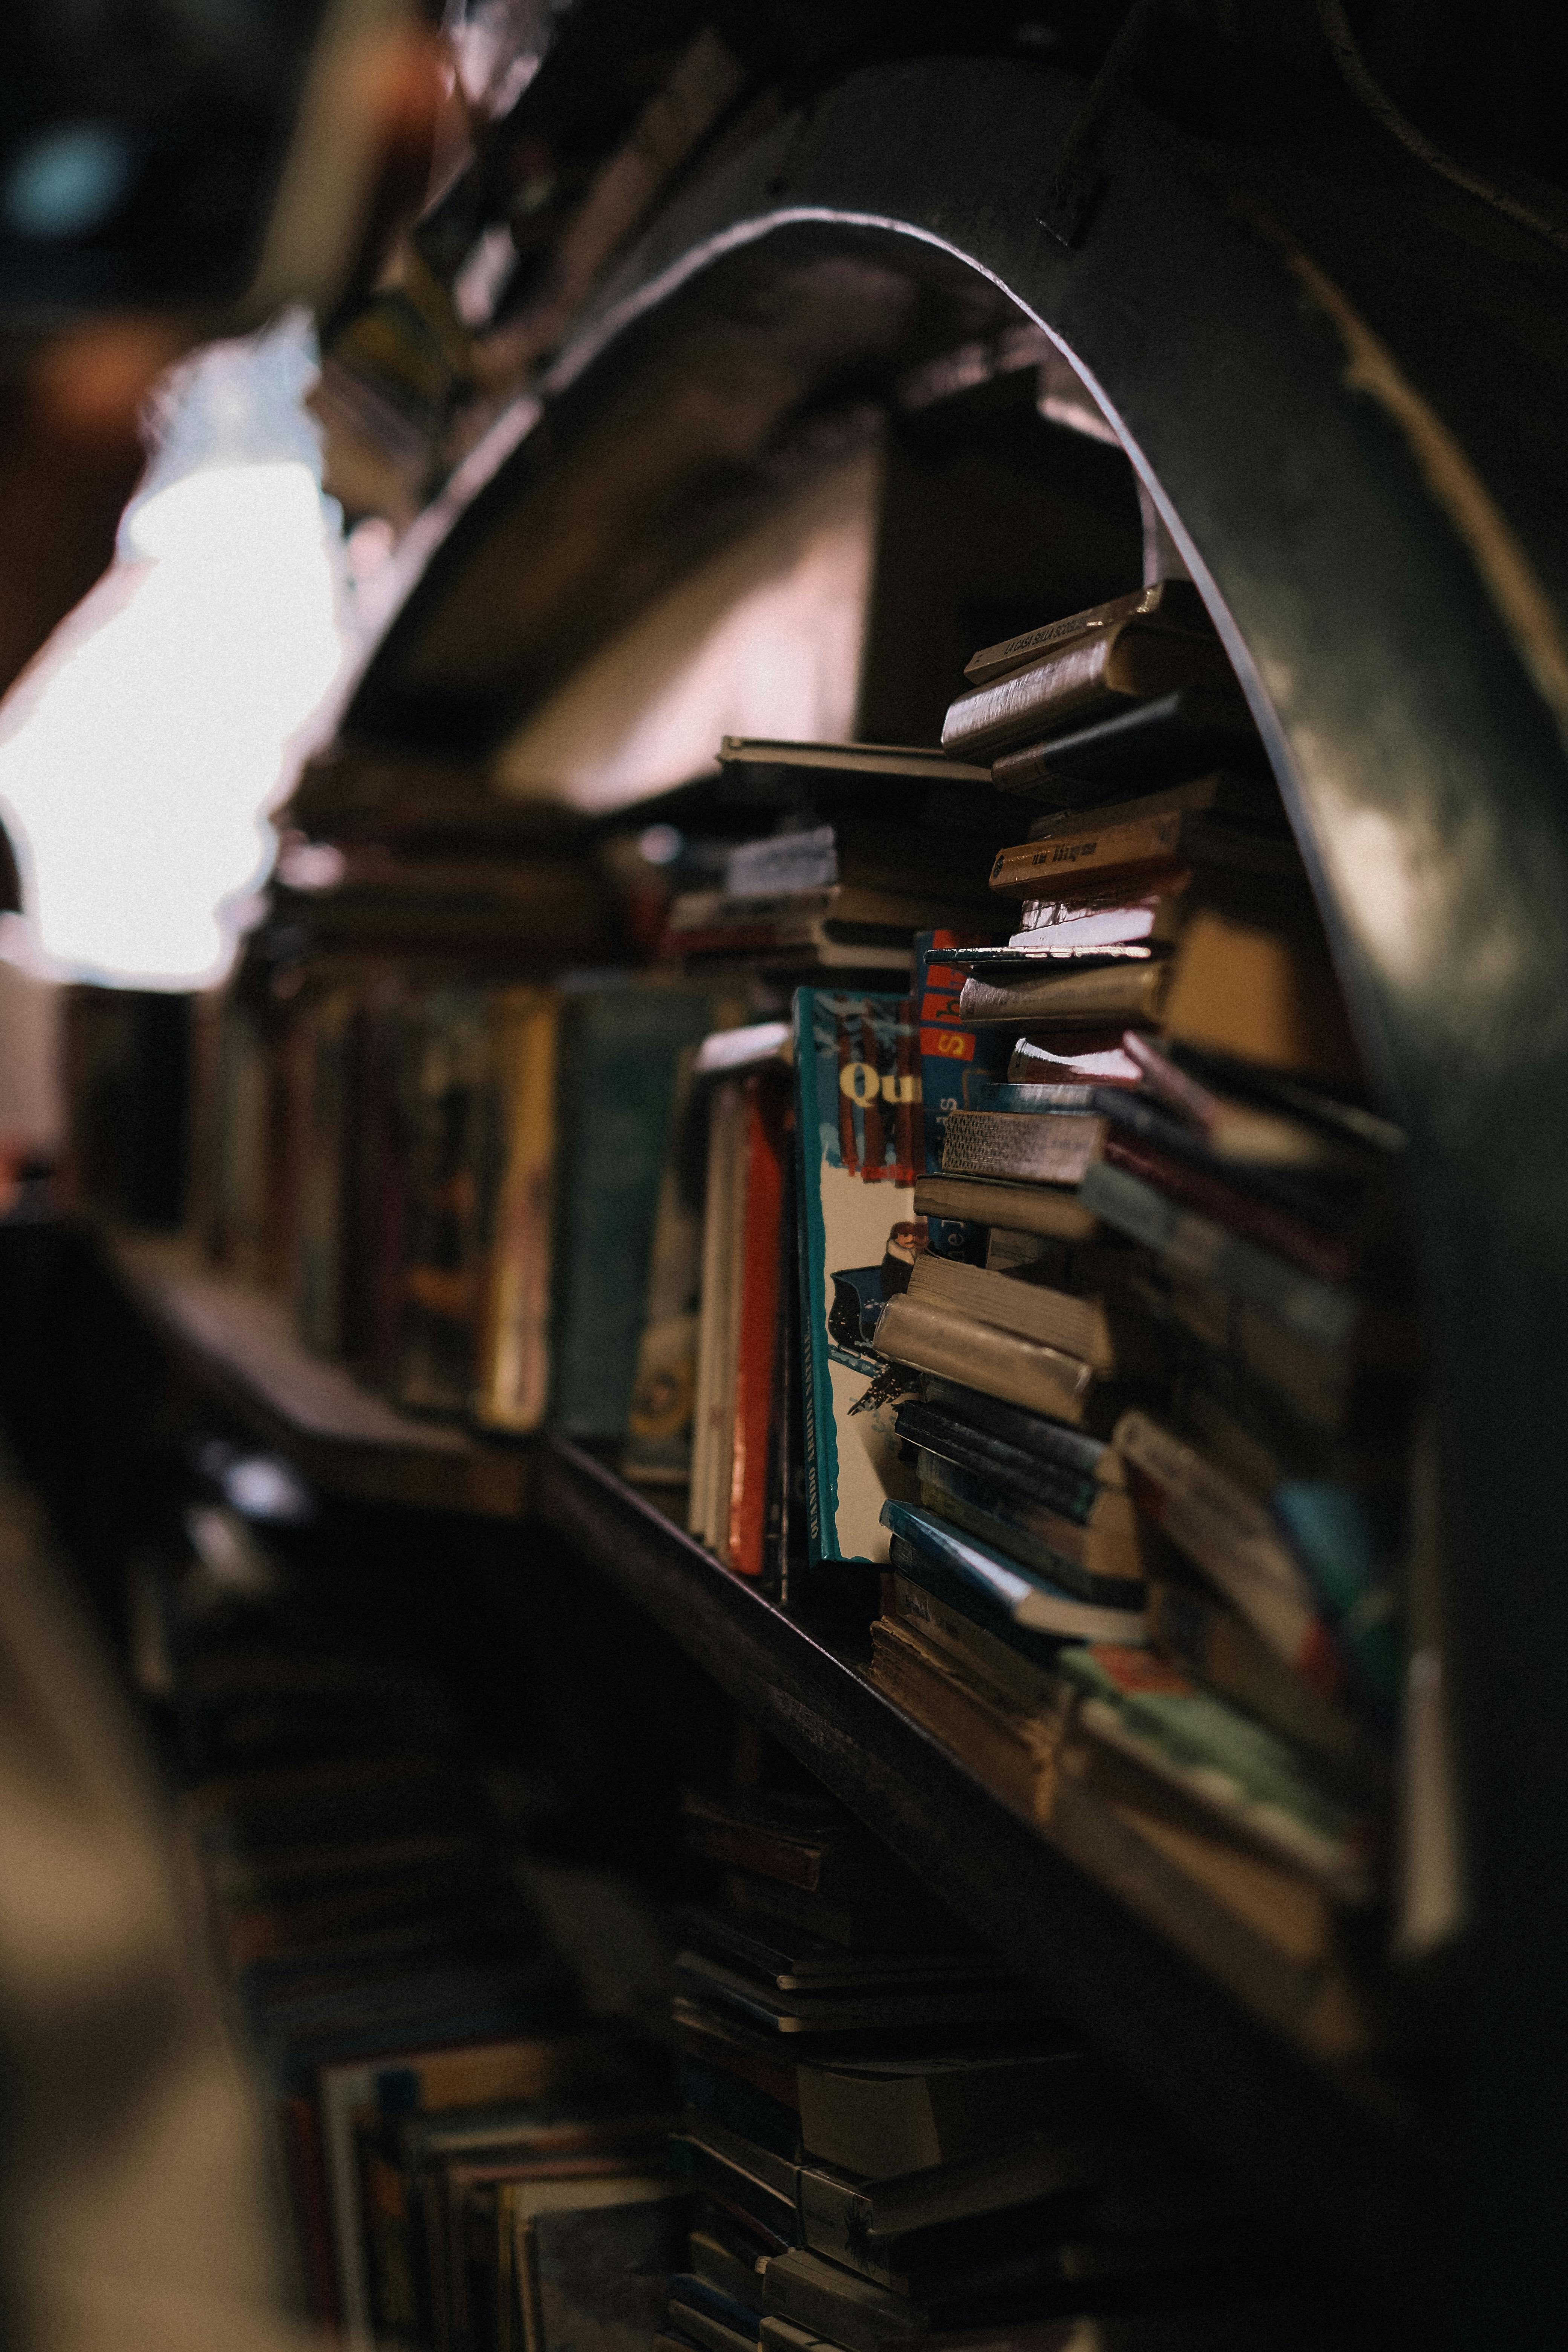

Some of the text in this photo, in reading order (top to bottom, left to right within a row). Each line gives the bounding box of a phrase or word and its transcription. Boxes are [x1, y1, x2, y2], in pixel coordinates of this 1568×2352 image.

[1004, 643, 1015, 655] LA
[1014, 635, 1034, 652] CASA
[1032, 628, 1054, 645] SULLA
[806, 1398, 815, 1462] ARRIVA
[808, 1467, 819, 1539] QUANDO
